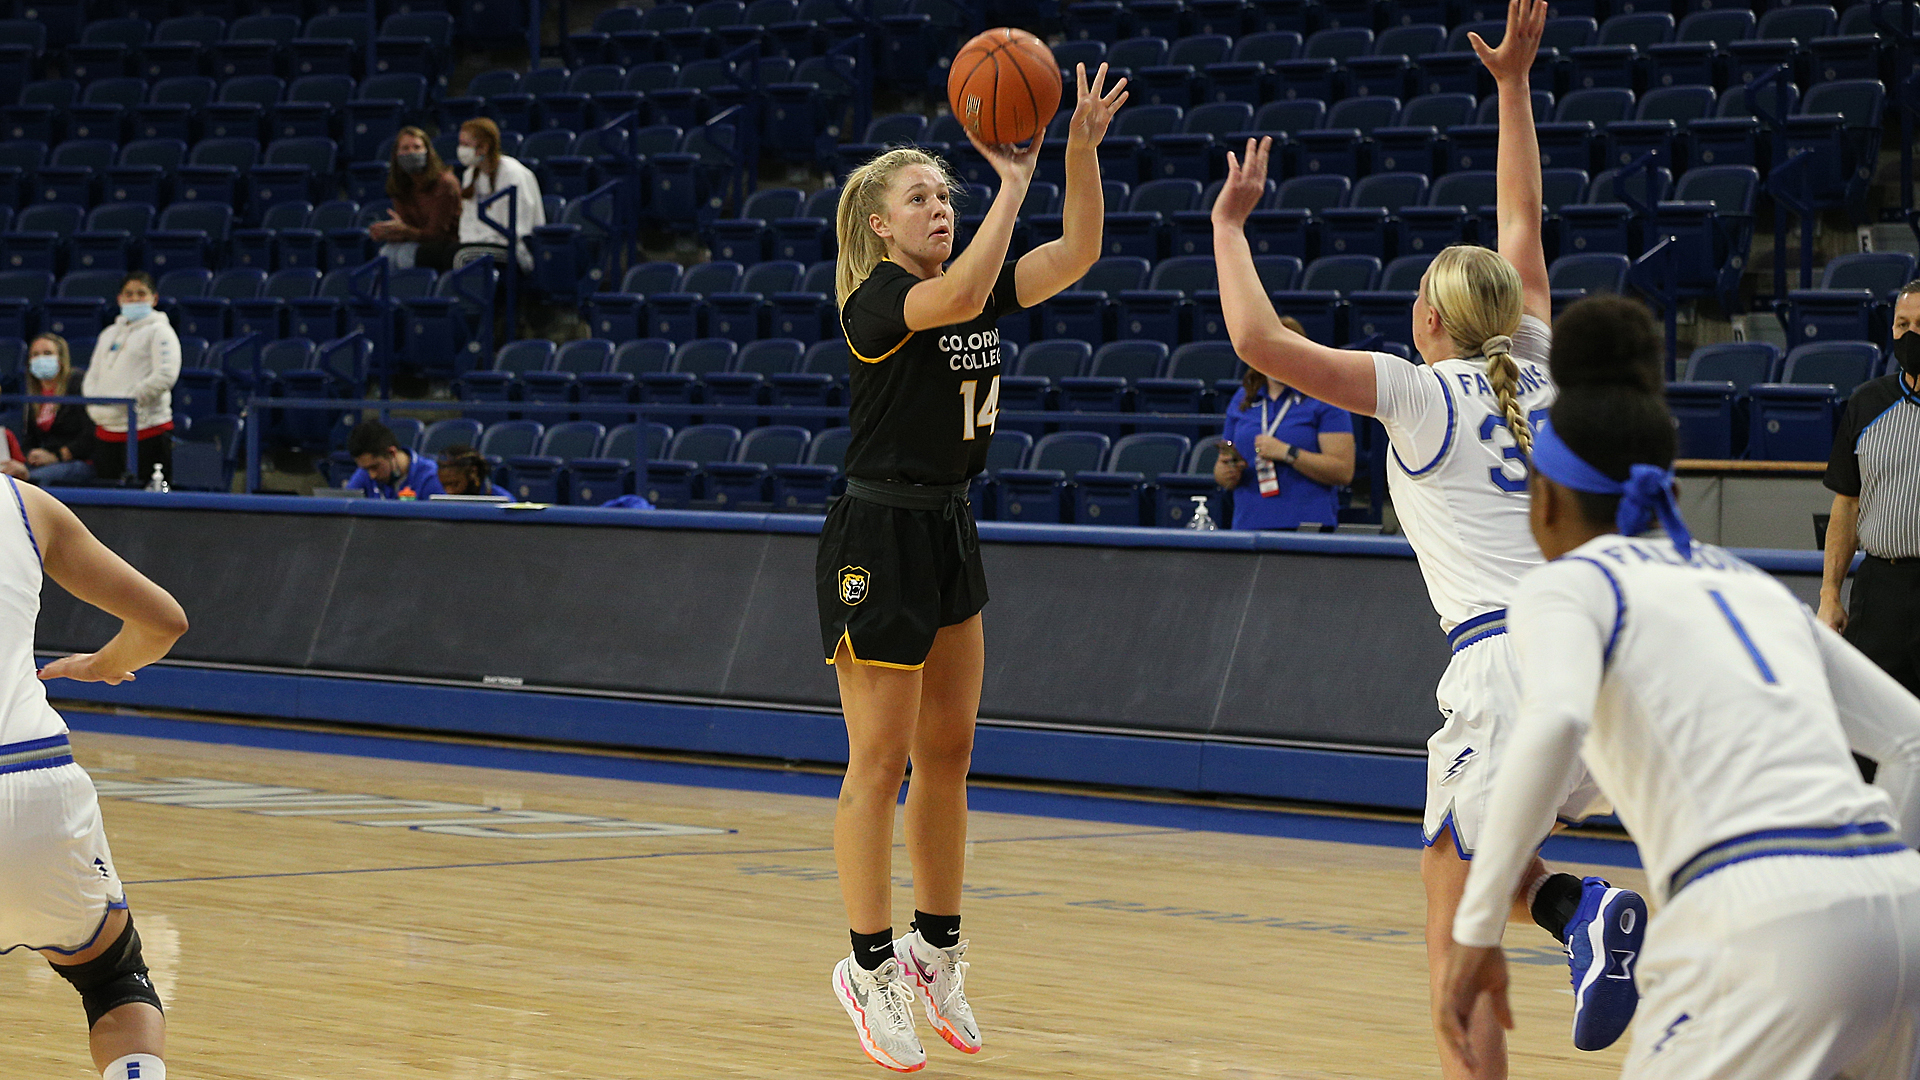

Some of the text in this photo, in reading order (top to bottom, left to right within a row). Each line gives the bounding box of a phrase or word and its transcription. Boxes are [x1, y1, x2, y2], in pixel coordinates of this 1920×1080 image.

[959, 374, 1000, 441] 14
[1478, 407, 1552, 494] 3
[1707, 589, 1778, 684] 1
